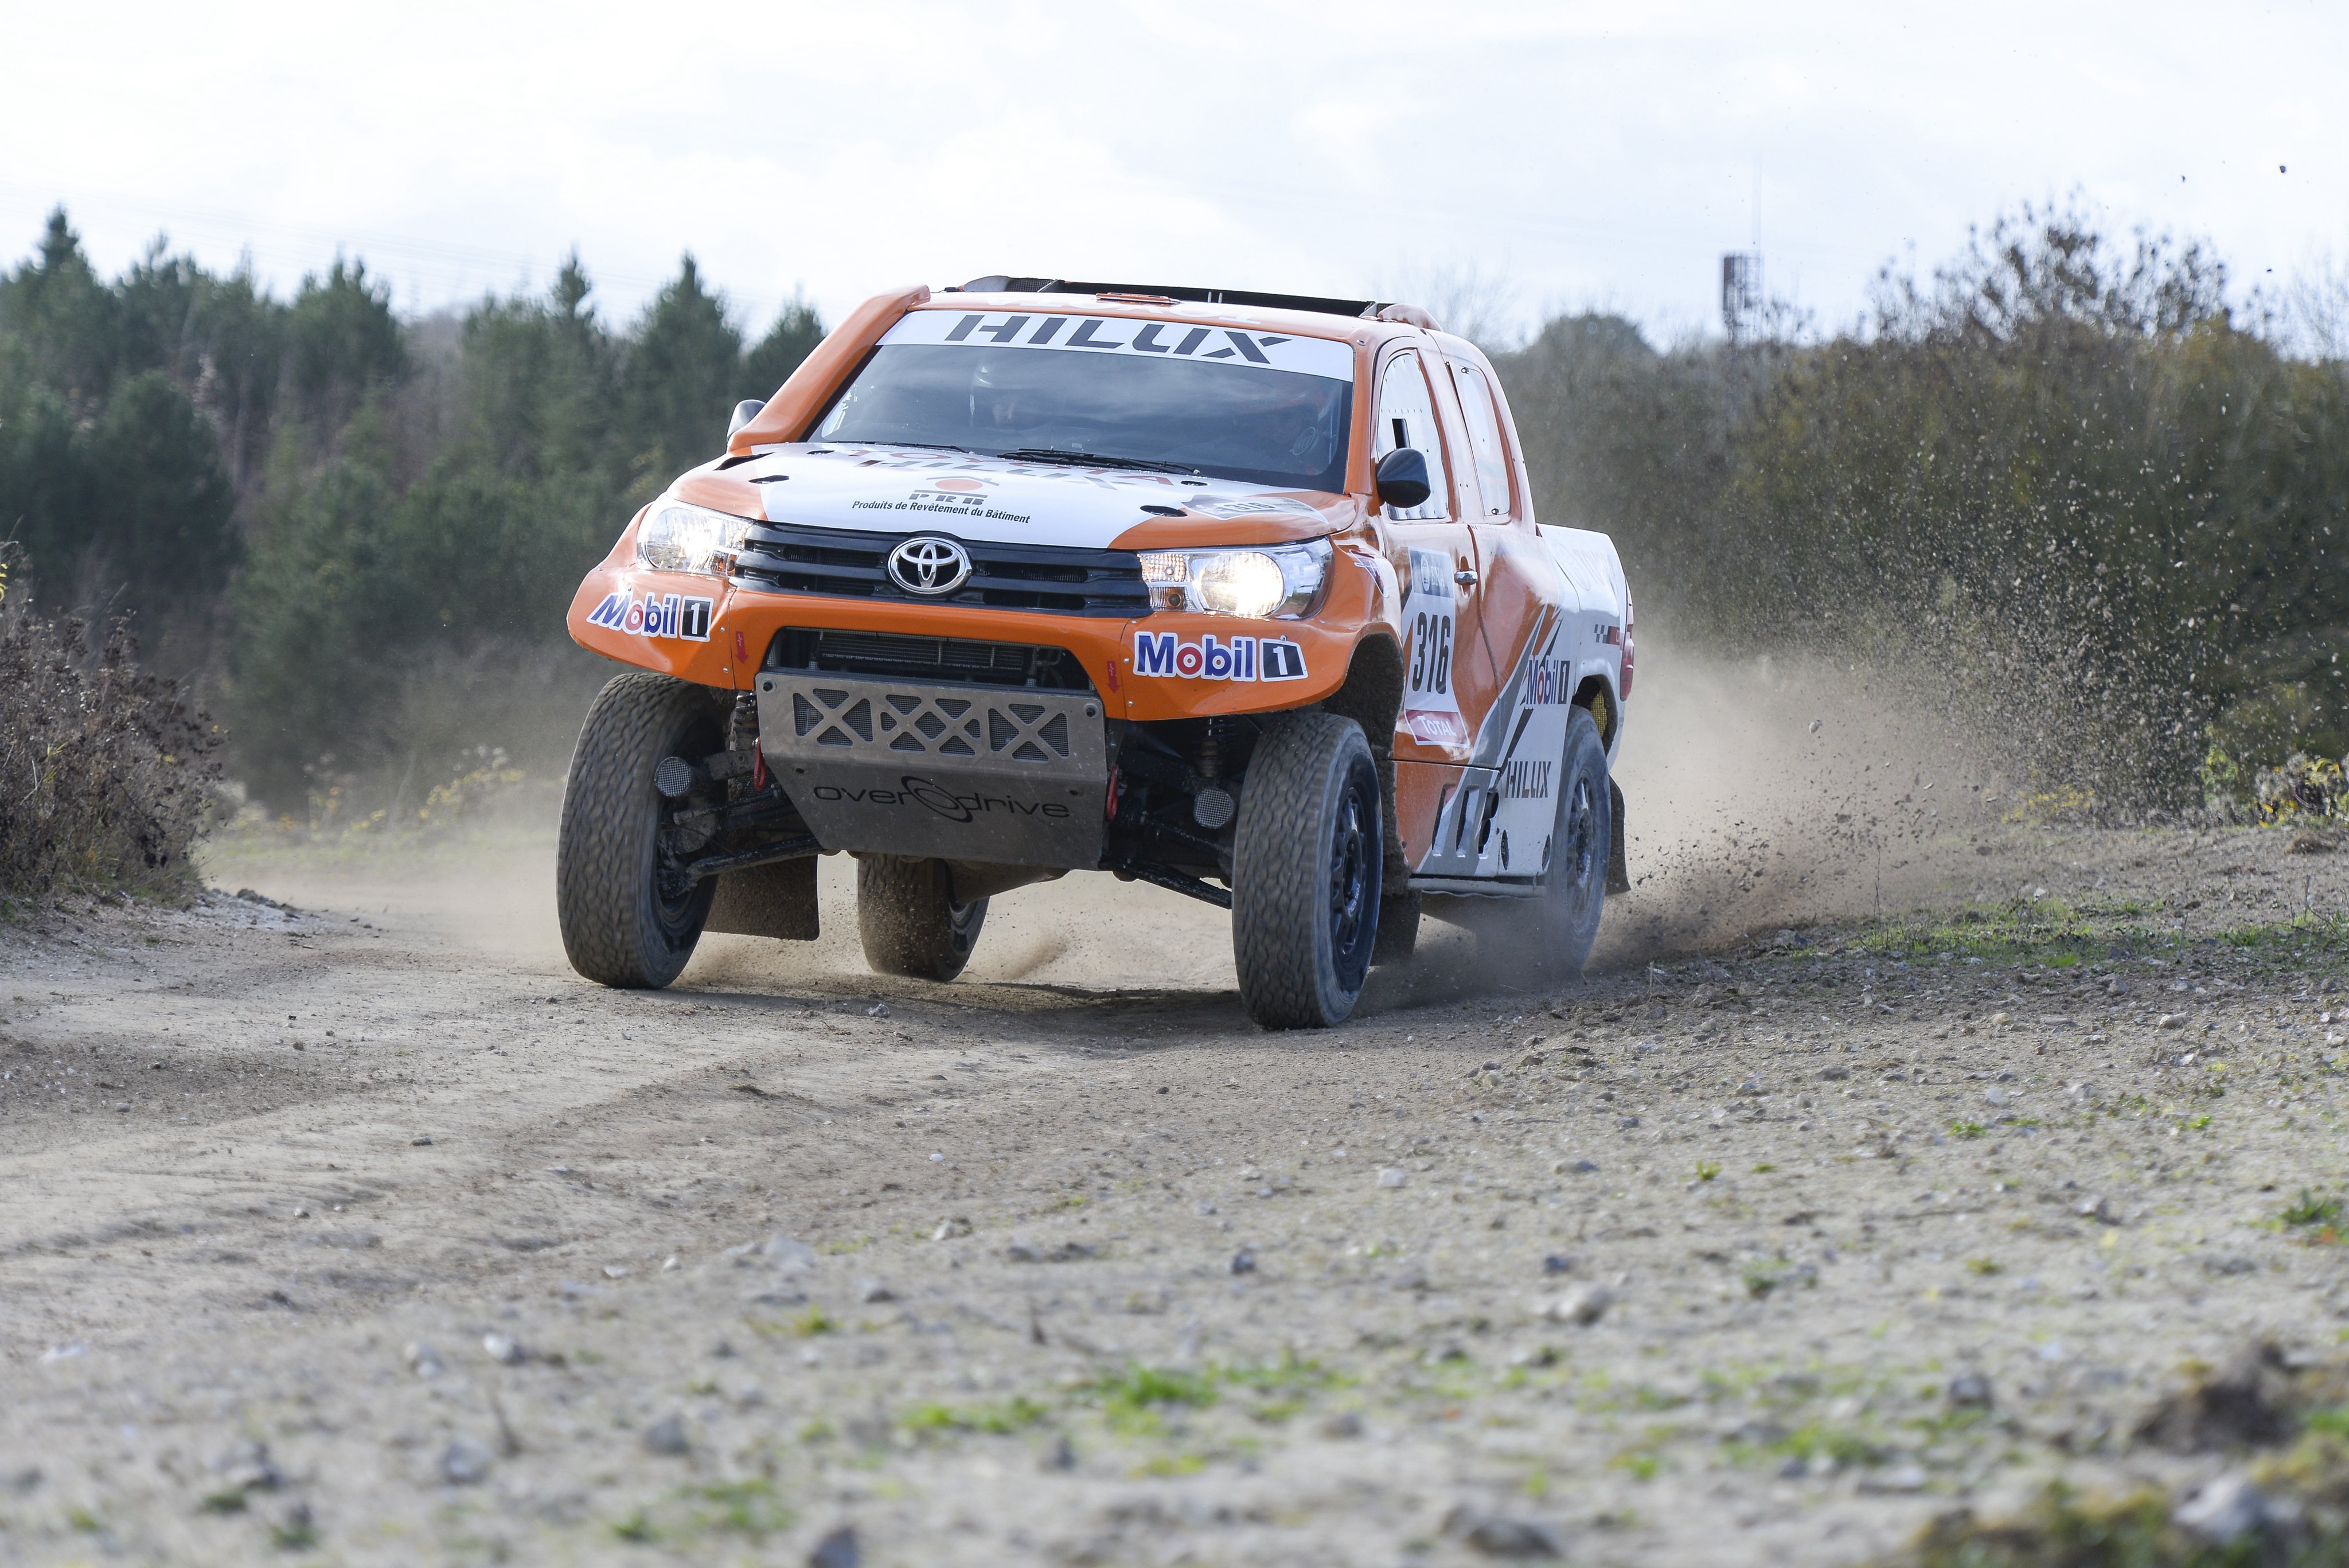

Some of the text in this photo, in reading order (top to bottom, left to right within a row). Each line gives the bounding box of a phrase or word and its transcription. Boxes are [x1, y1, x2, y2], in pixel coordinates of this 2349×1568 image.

[945, 315, 1293, 364] HILUX
[852, 501, 1031, 524] Produits de Revêtement du Bâtiment
[909, 493, 985, 505] PRB
[590, 594, 678, 635] Mobil
[1136, 634, 1254, 678] Mobil
[1412, 612, 1450, 694] 316
[1525, 660, 1558, 705] Mobil
[1505, 761, 1551, 798] HILUX
